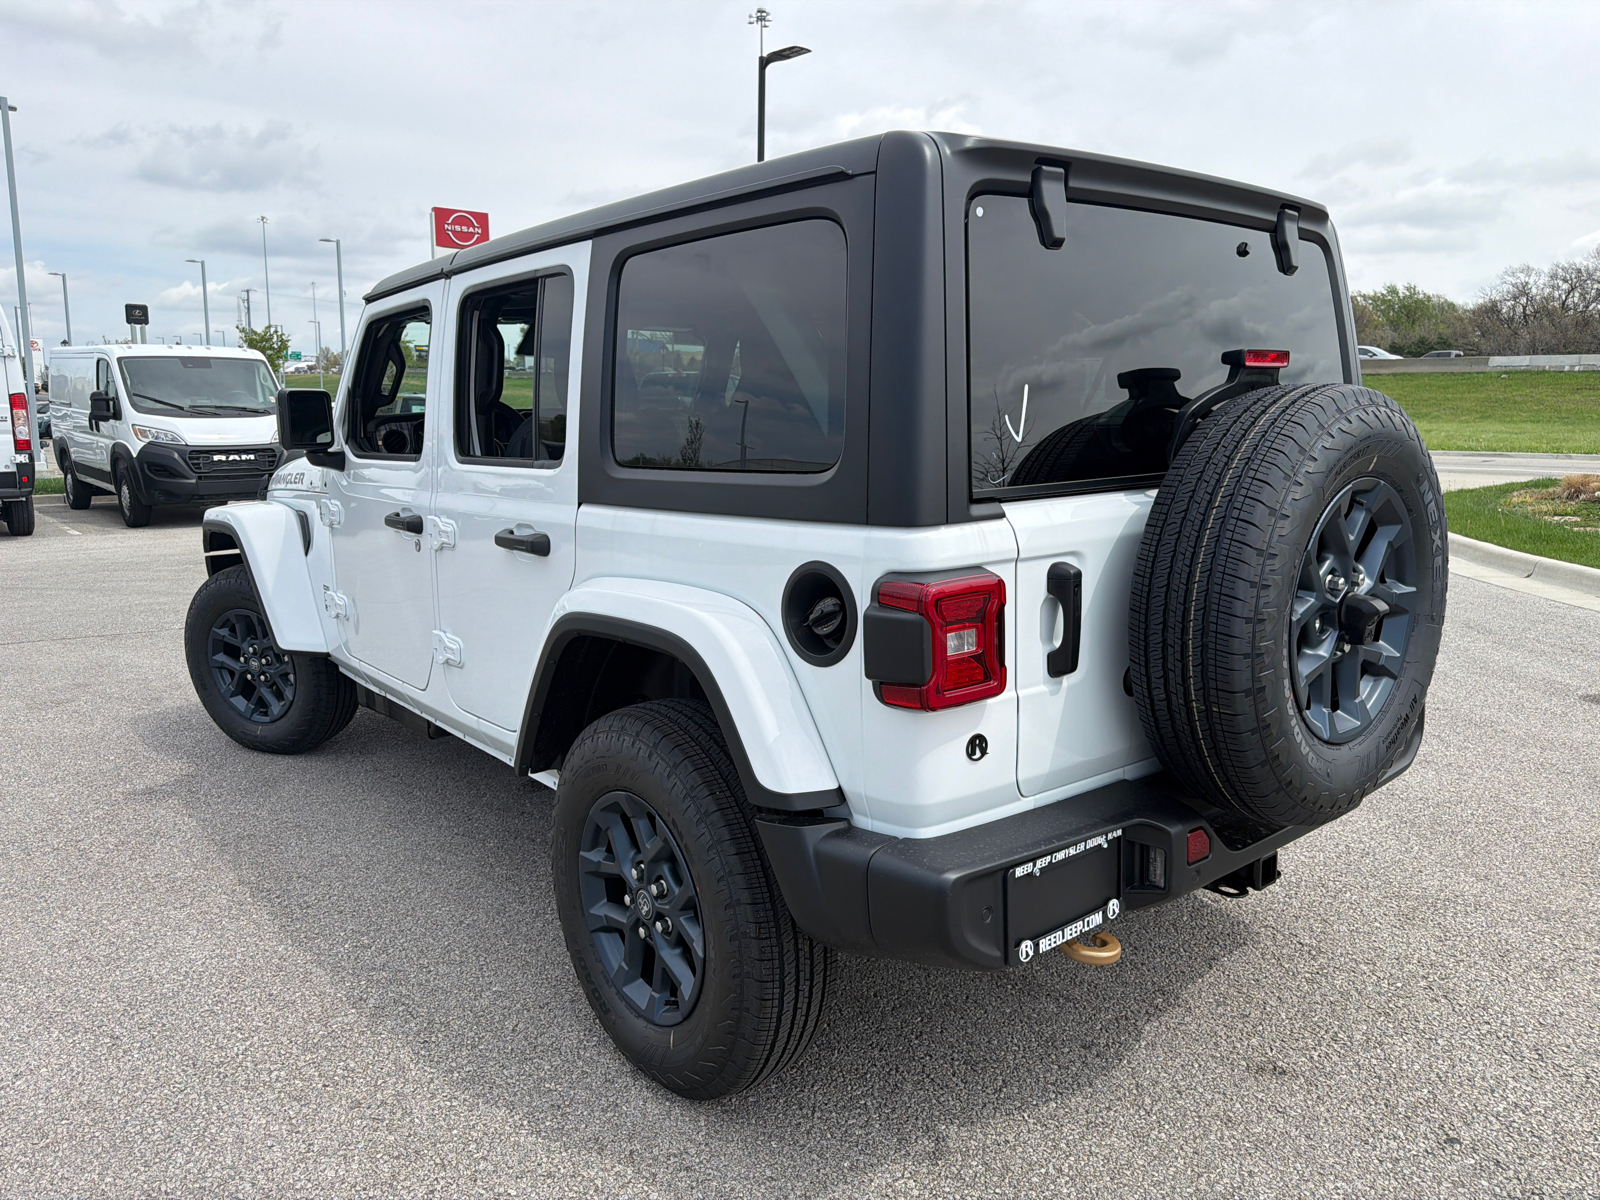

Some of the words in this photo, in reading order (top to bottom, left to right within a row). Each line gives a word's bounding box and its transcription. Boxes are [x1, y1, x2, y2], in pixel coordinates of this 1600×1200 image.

[444, 223, 482, 234] NISSAN
[1015, 862, 1033, 878] REED
[1034, 855, 1051, 871] JEEP
[1052, 842, 1085, 863] CHRYSLER
[1086, 834, 1106, 849] DODGE
[1107, 828, 1122, 840] RAM
[1039, 910, 1103, 954] REEDJEEP.COM
